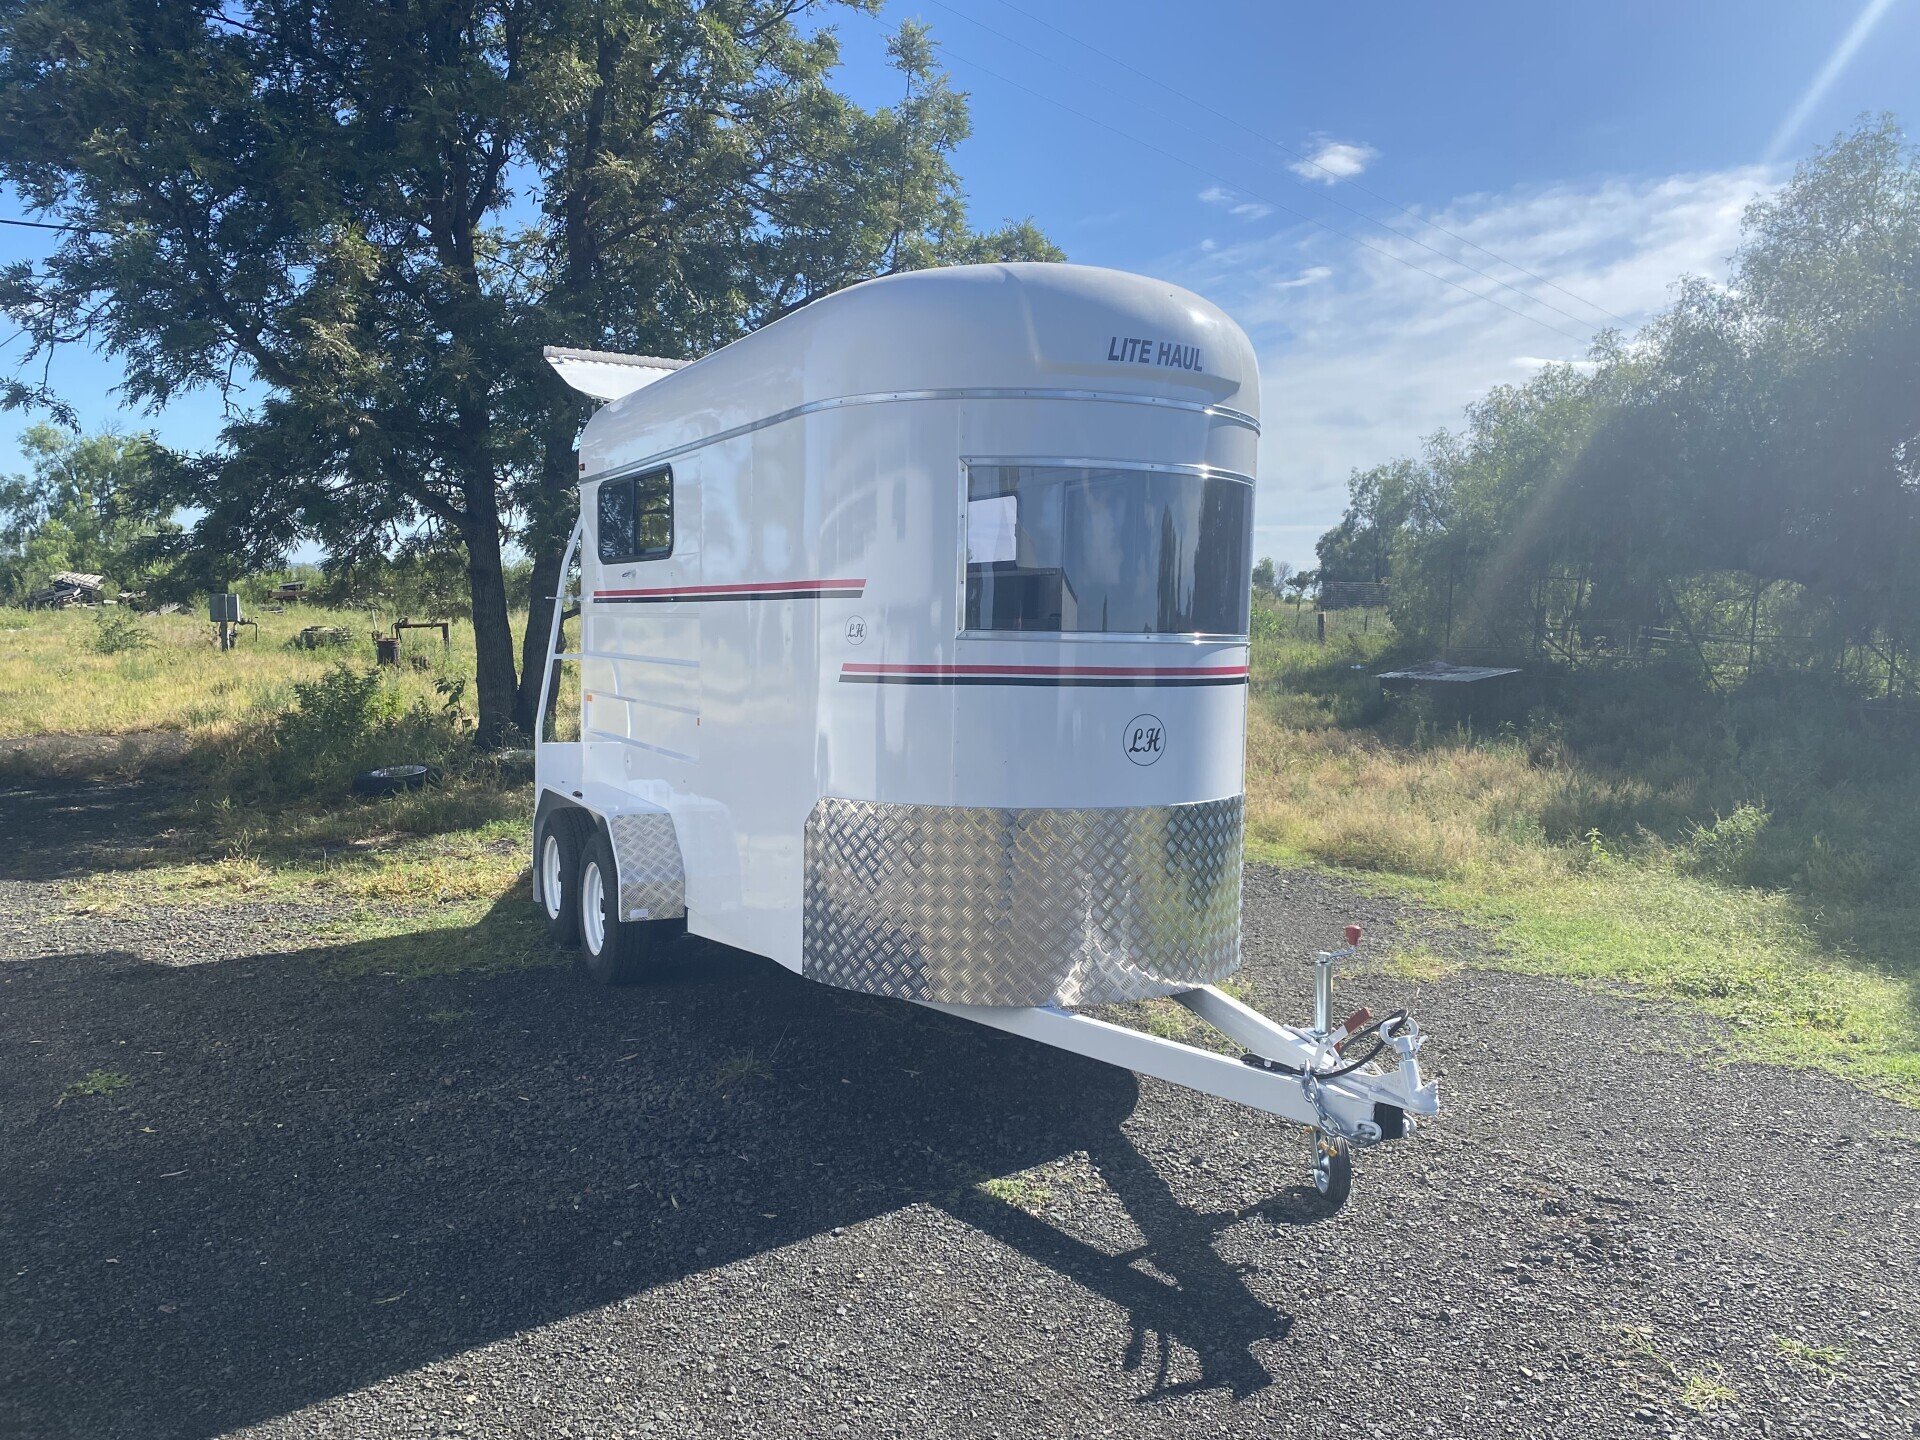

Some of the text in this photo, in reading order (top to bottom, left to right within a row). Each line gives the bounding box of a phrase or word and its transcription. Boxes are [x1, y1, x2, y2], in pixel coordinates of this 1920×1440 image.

[1108, 337, 1202, 372] LITE HAUL
[848, 623, 865, 638] LH
[1129, 727, 1161, 752] LH
